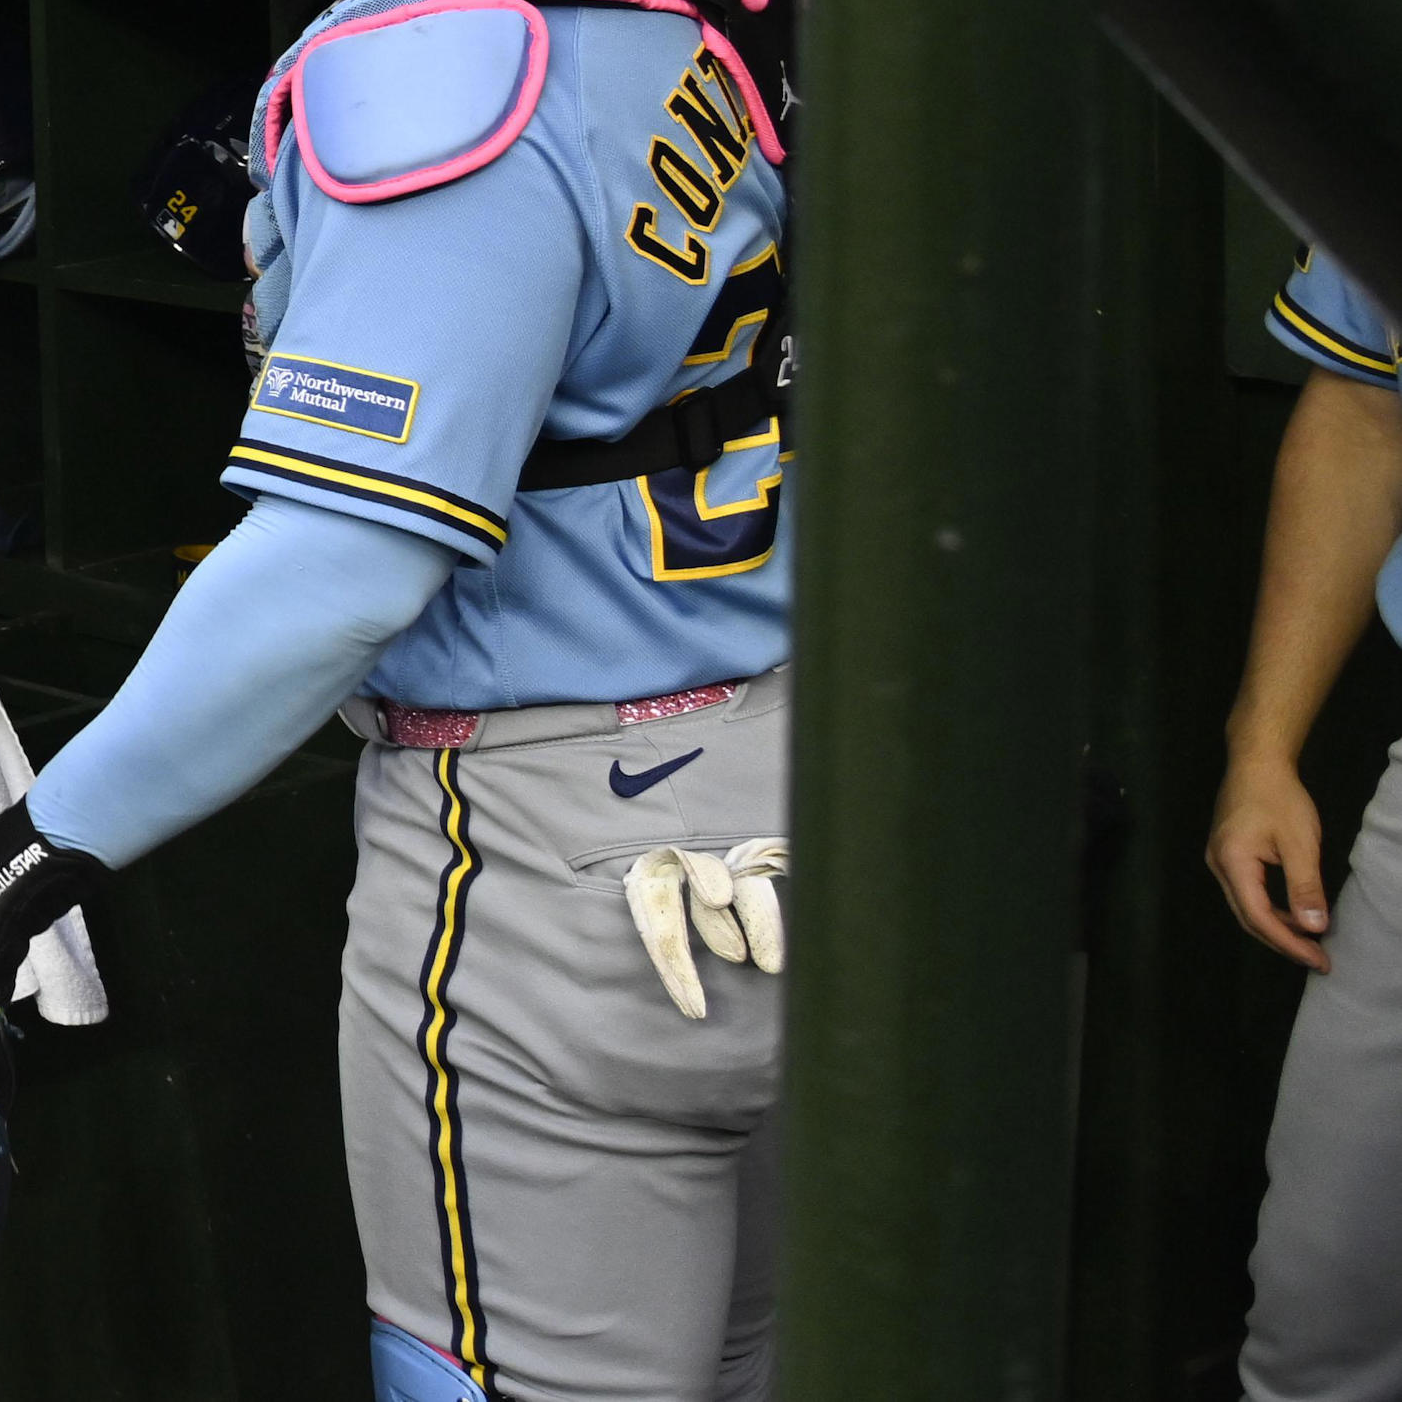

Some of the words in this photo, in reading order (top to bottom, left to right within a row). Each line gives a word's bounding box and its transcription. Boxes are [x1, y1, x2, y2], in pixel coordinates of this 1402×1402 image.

[166, 189, 199, 224] 24
[289, 387, 347, 413] Mutual
[294, 372, 407, 412] Northwestern
